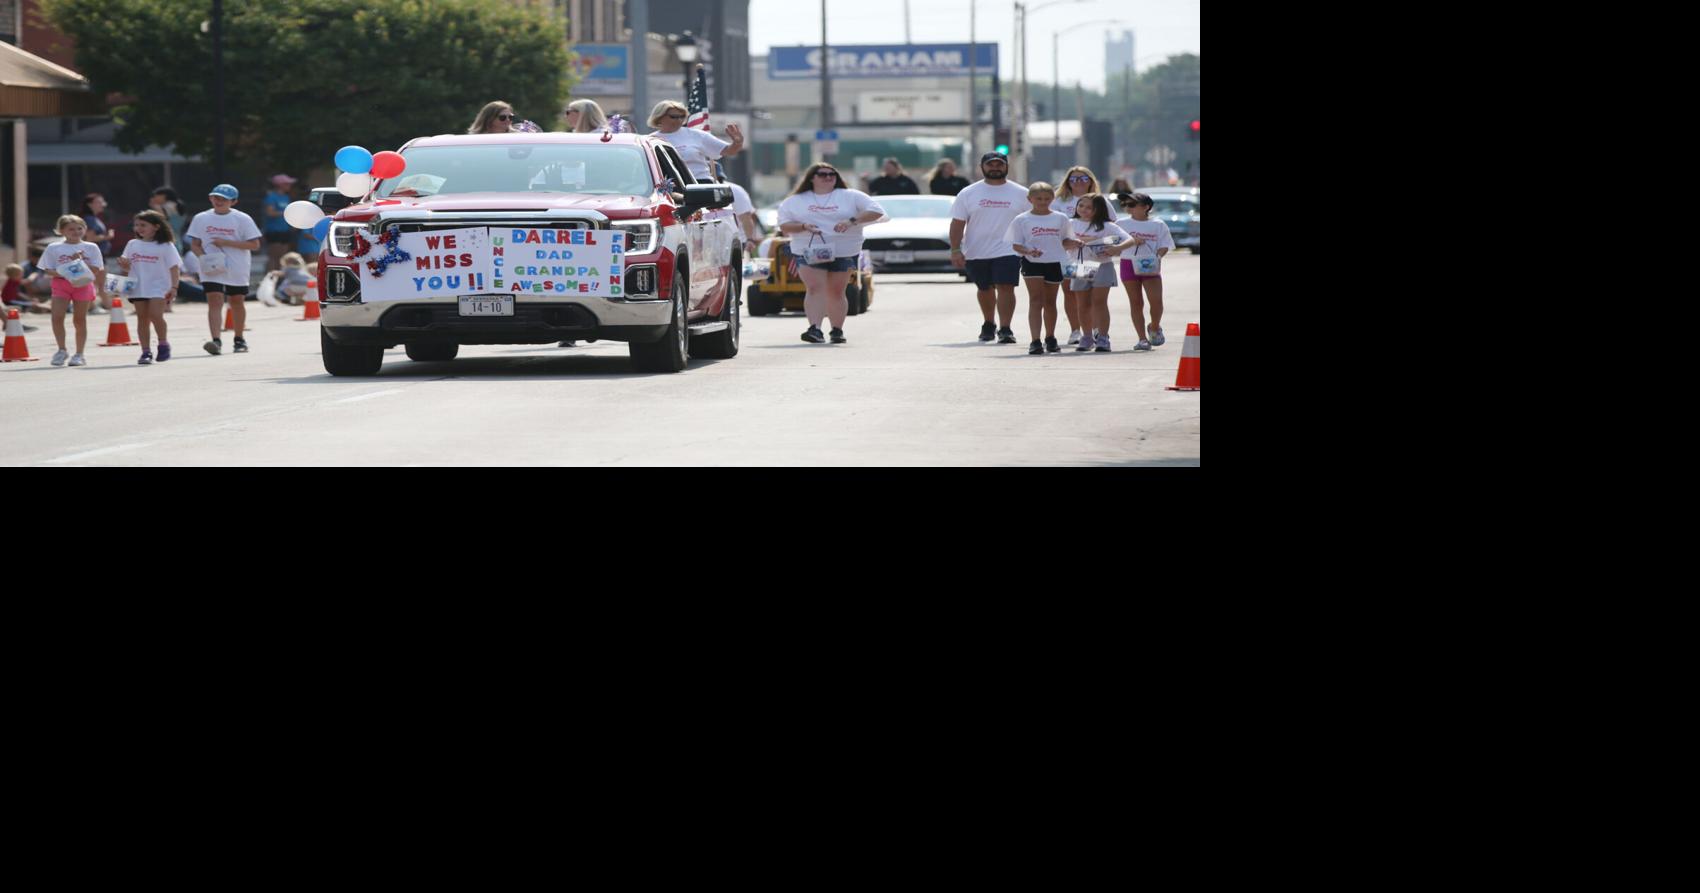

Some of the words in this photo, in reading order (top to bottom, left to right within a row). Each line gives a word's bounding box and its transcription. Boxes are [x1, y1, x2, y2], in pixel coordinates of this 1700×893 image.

[806, 48, 962, 67] GRAHAM
[425, 235, 456, 250] WE
[512, 229, 597, 245] DARREL
[416, 253, 473, 270] MISS
[493, 237, 504, 288] UNCLE
[536, 250, 573, 259] DAD
[514, 266, 599, 276] GRANDPA
[610, 234, 622, 295] FRIEND
[412, 275, 460, 291] YOU
[511, 280, 600, 293] AWESOME!!
[472, 302, 502, 313] 14-10
